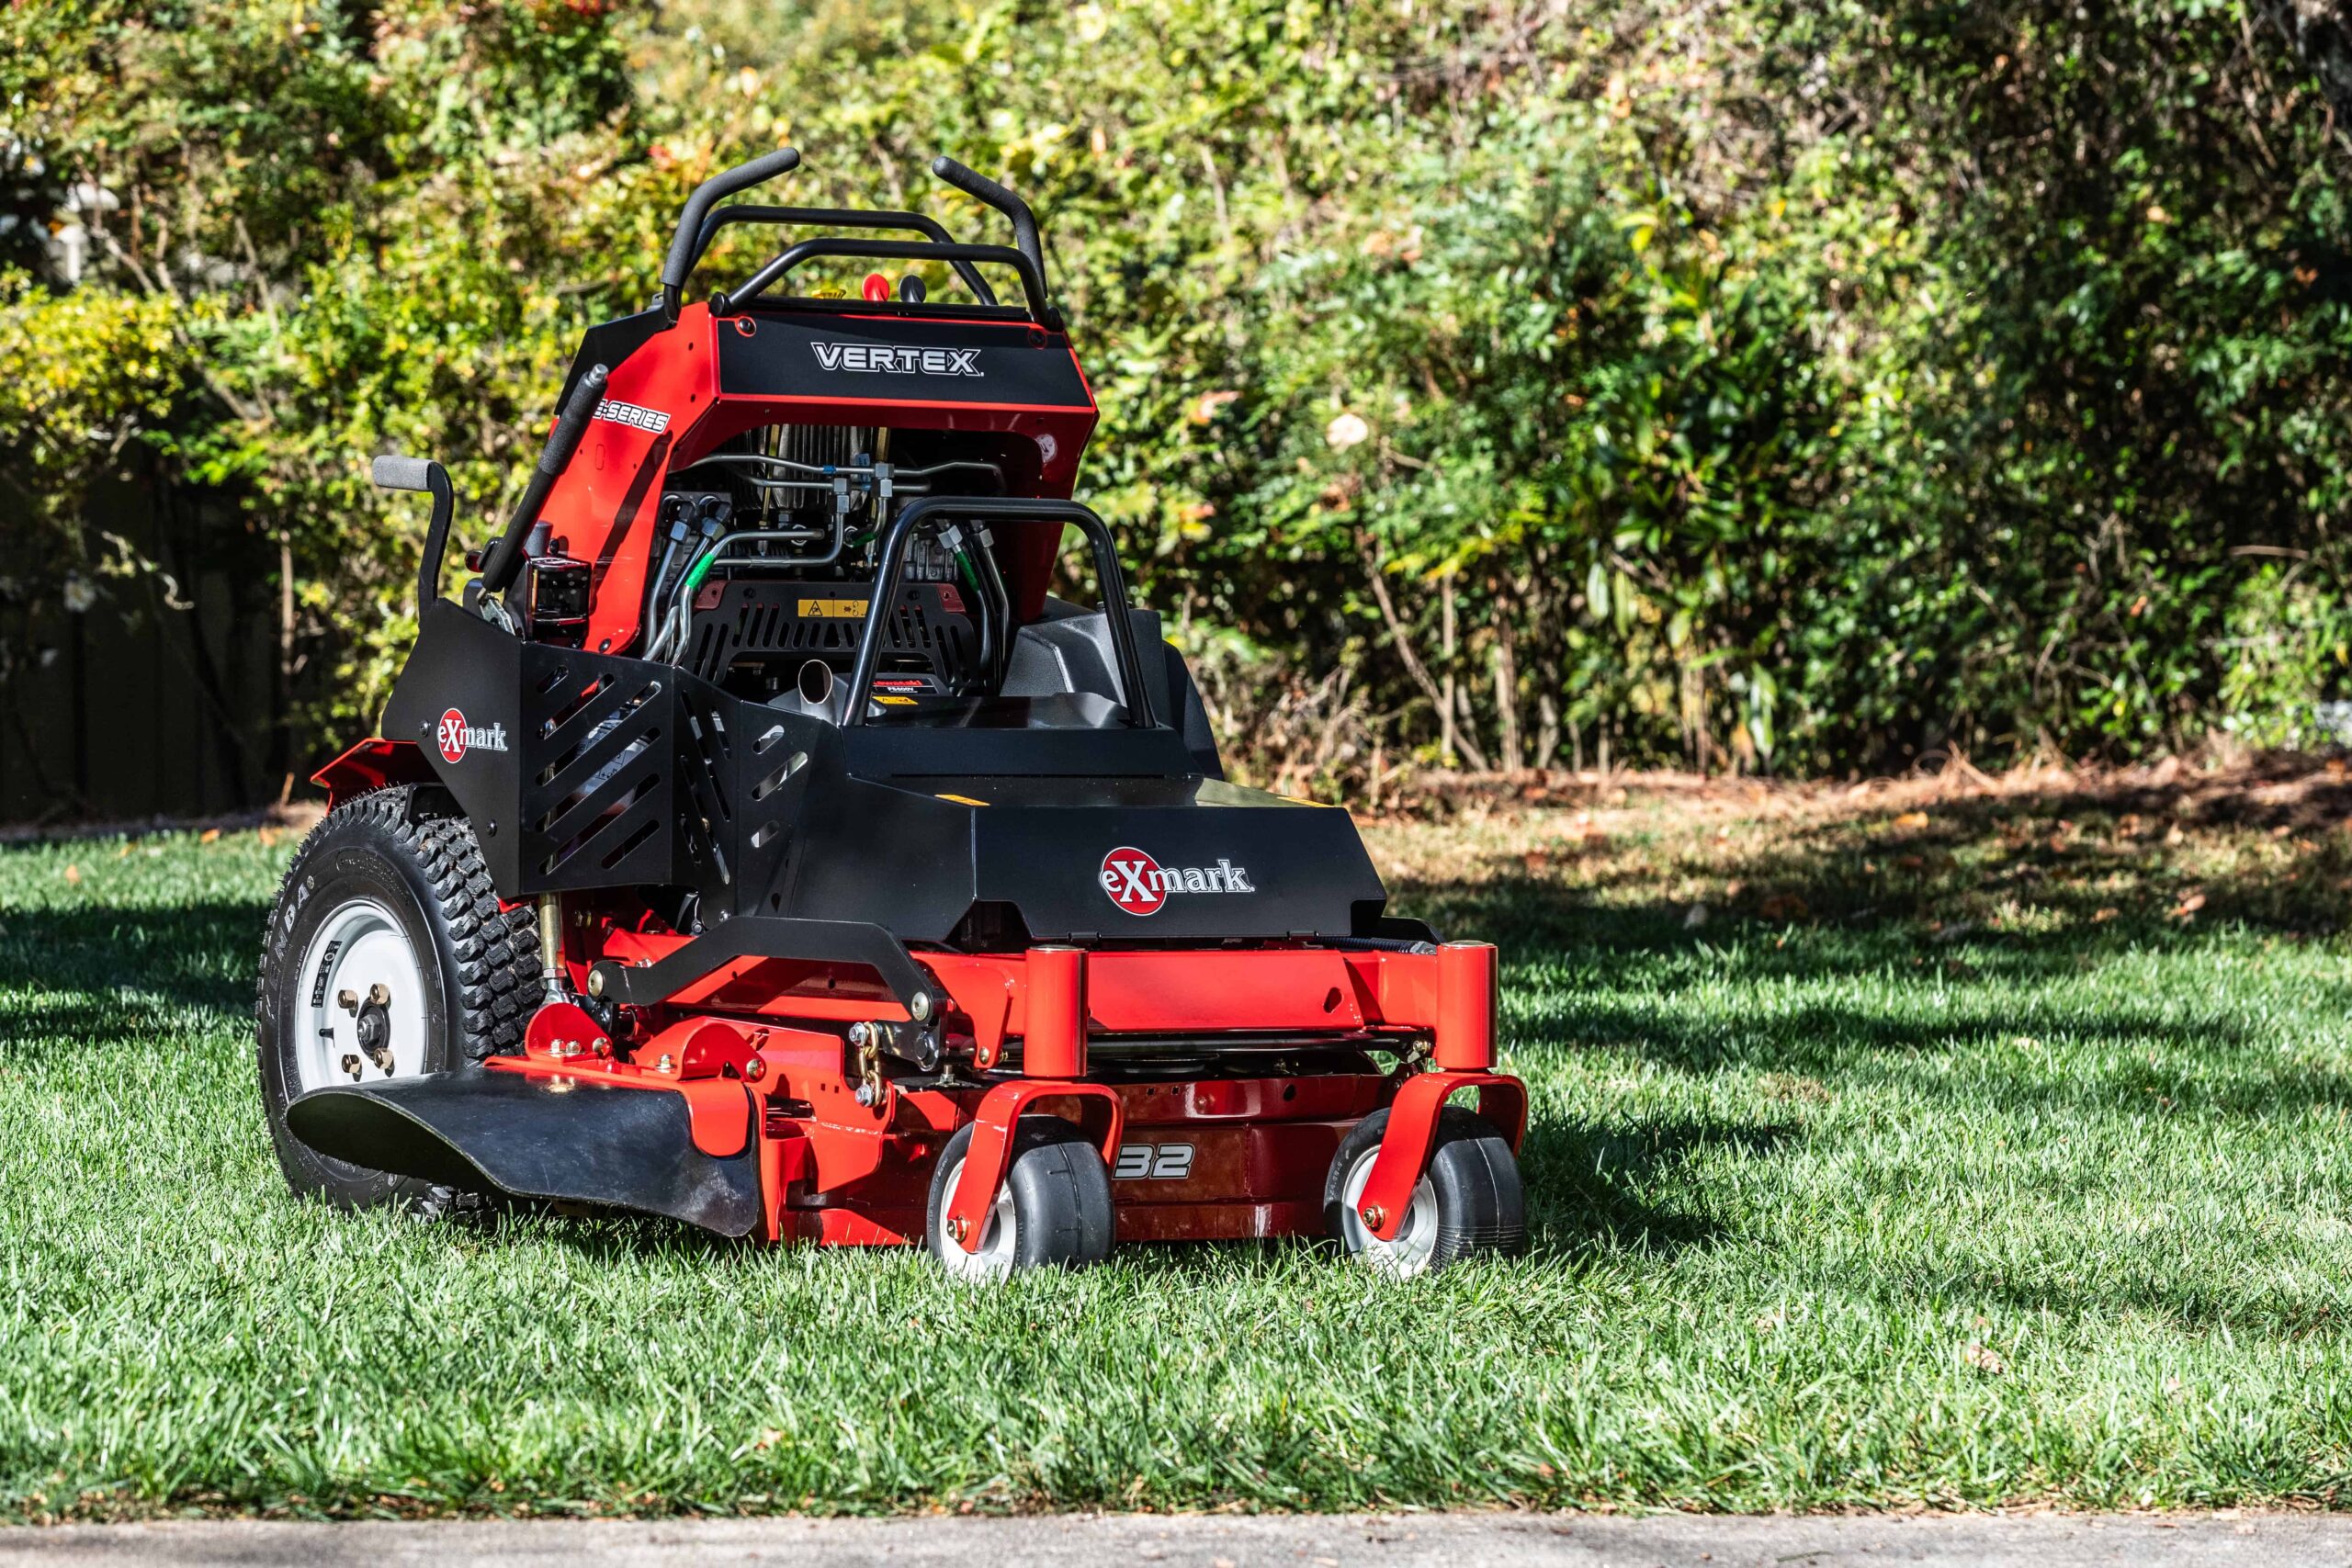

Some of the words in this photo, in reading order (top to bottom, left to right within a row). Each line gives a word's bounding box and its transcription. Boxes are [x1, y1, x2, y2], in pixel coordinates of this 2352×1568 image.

[811, 343, 981, 377] VERTEX
[436, 717, 507, 752] eXmark
[1100, 858, 1255, 903] eXmark
[1112, 1144, 1195, 1179] 32
